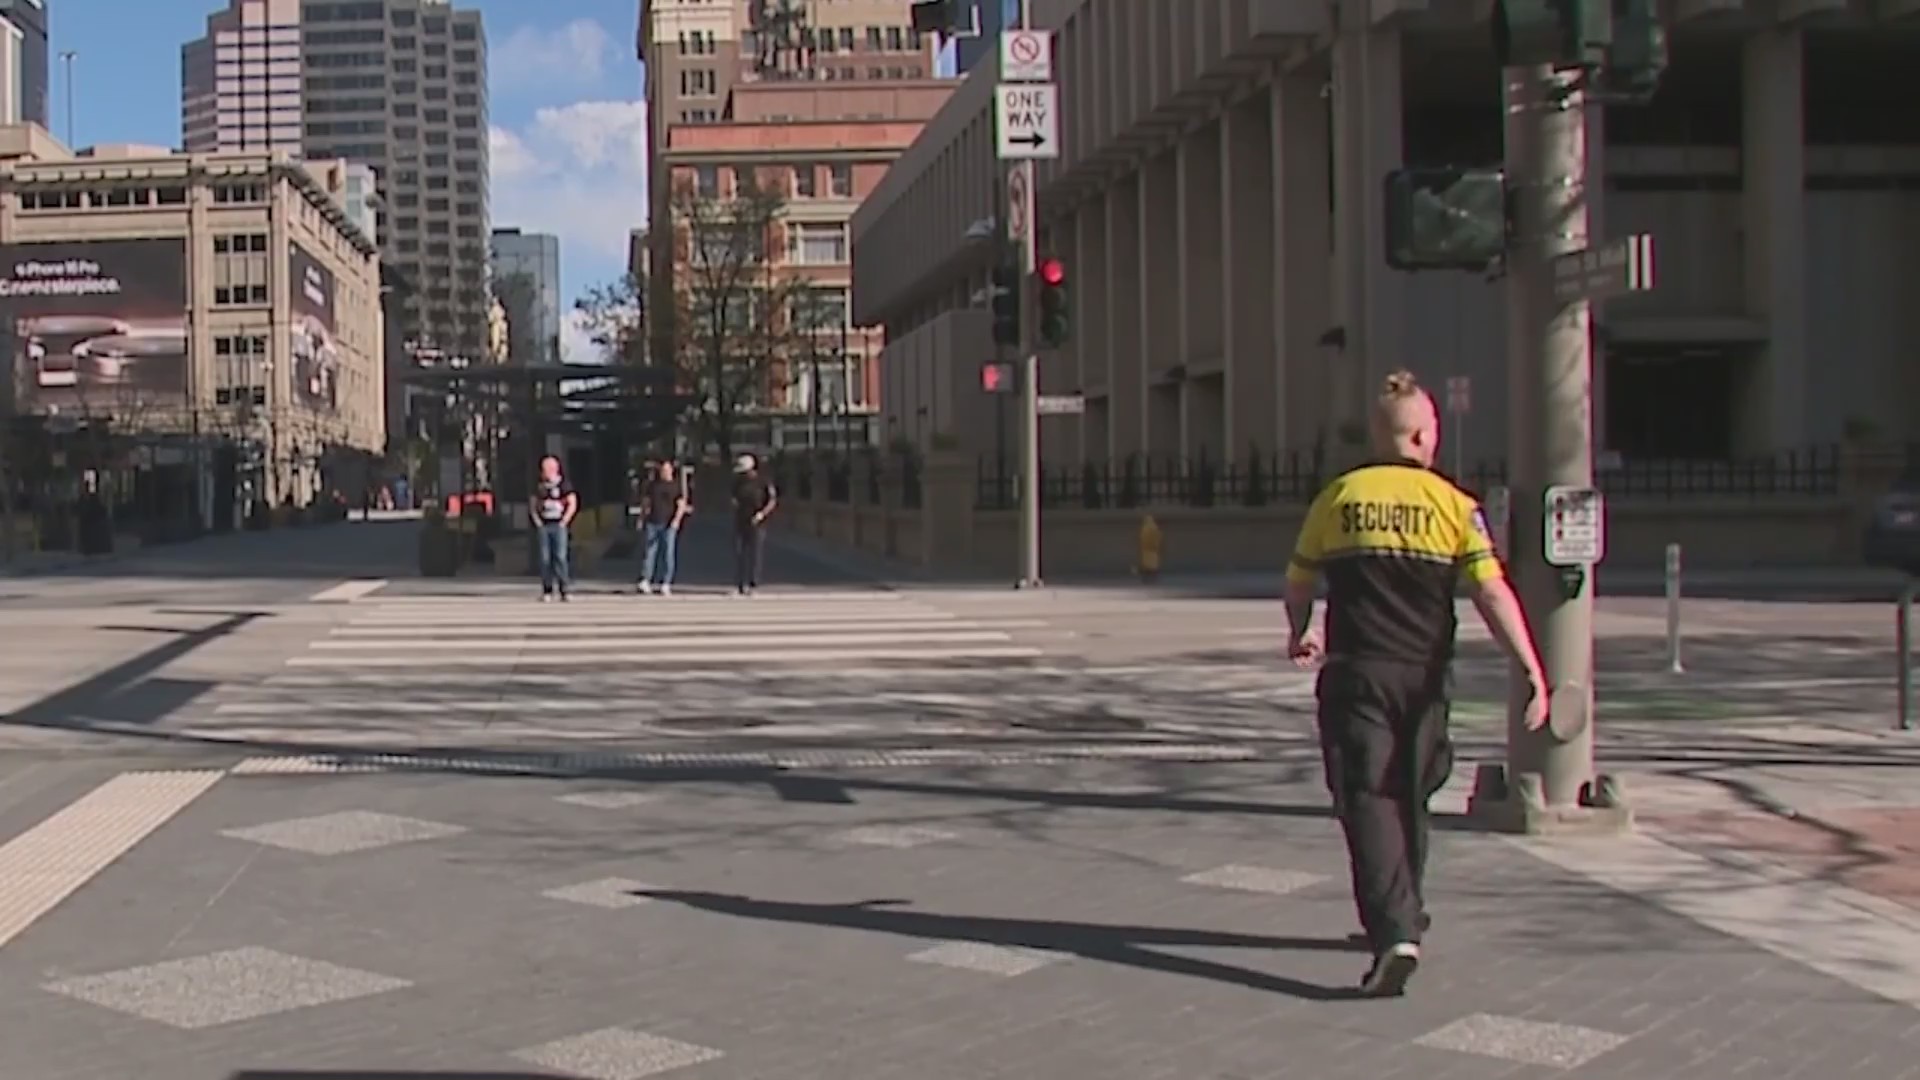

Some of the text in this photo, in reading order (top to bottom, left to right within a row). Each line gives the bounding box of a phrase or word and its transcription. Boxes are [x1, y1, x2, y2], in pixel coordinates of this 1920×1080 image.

[1005, 91, 1045, 108] ONE
[1008, 111, 1046, 127] WAY
[79, 260, 100, 275] Pro
[1341, 503, 1434, 535] SECURITY
